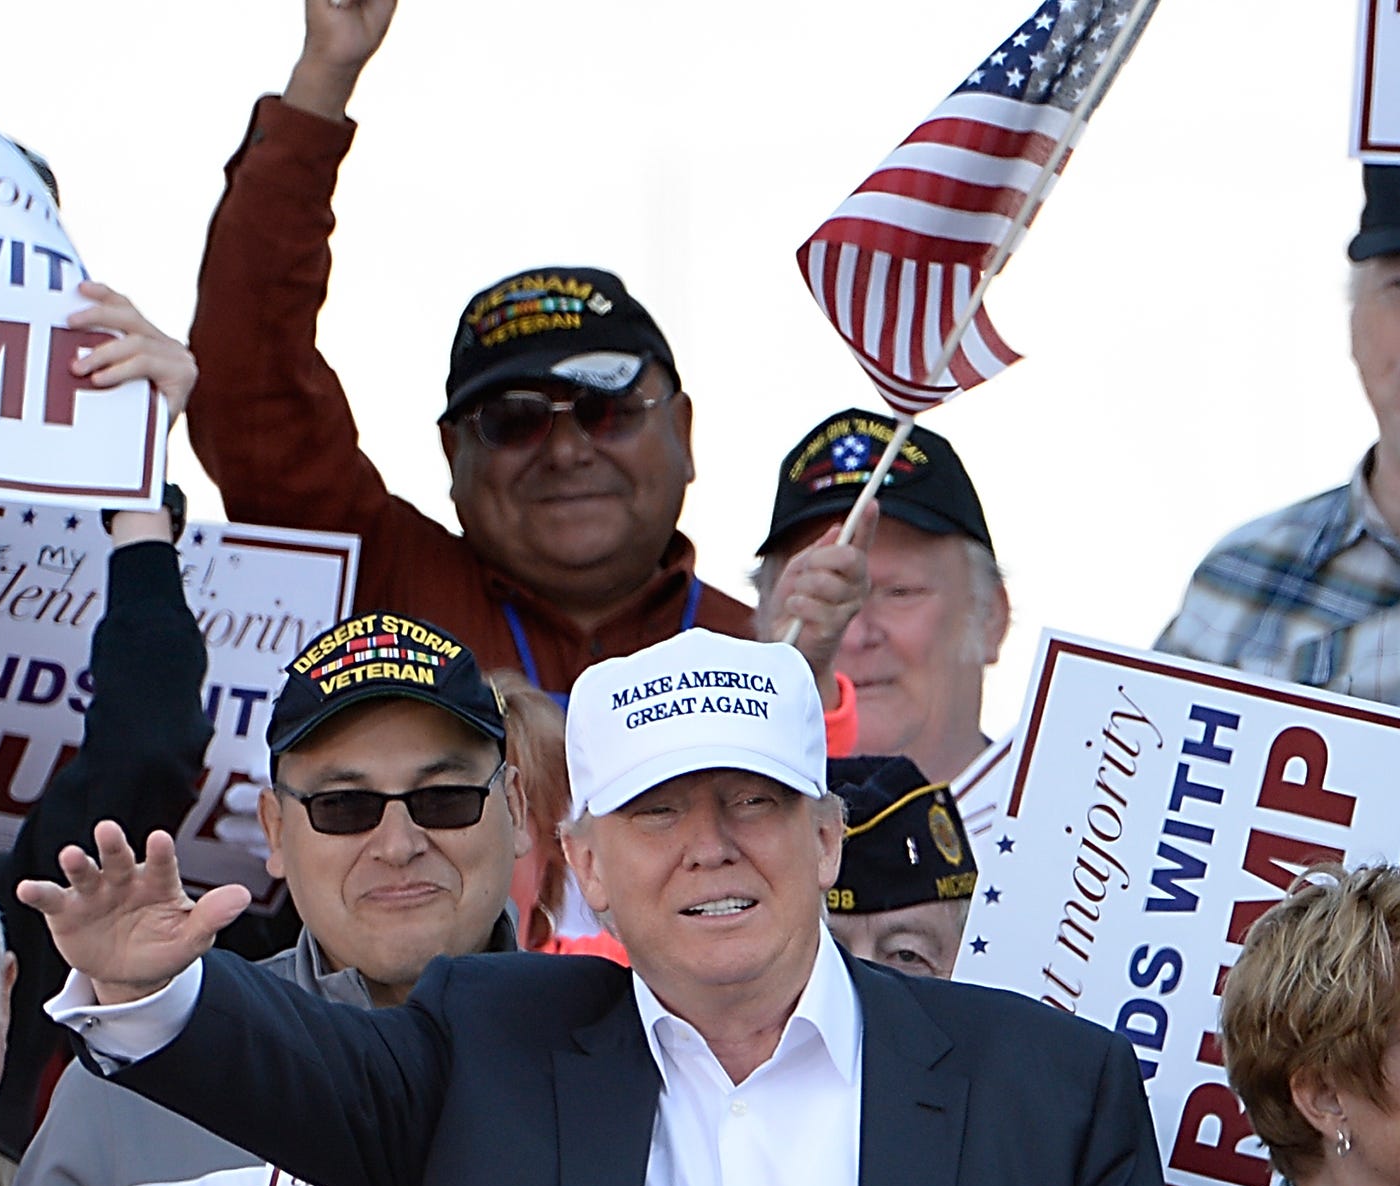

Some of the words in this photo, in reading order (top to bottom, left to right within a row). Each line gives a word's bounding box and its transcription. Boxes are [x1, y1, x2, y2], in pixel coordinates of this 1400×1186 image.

[480, 312, 582, 348] VETERAN
[293, 614, 379, 674] DESERT
[382, 615, 462, 660] STORM
[320, 662, 434, 695] VETERAN
[611, 679, 672, 711] MAKE
[675, 671, 778, 695] AMERICA
[626, 697, 697, 730] GREAT
[699, 698, 769, 720] AGAIN
[1056, 685, 1164, 963] majority
[1144, 703, 1241, 913] WITH
